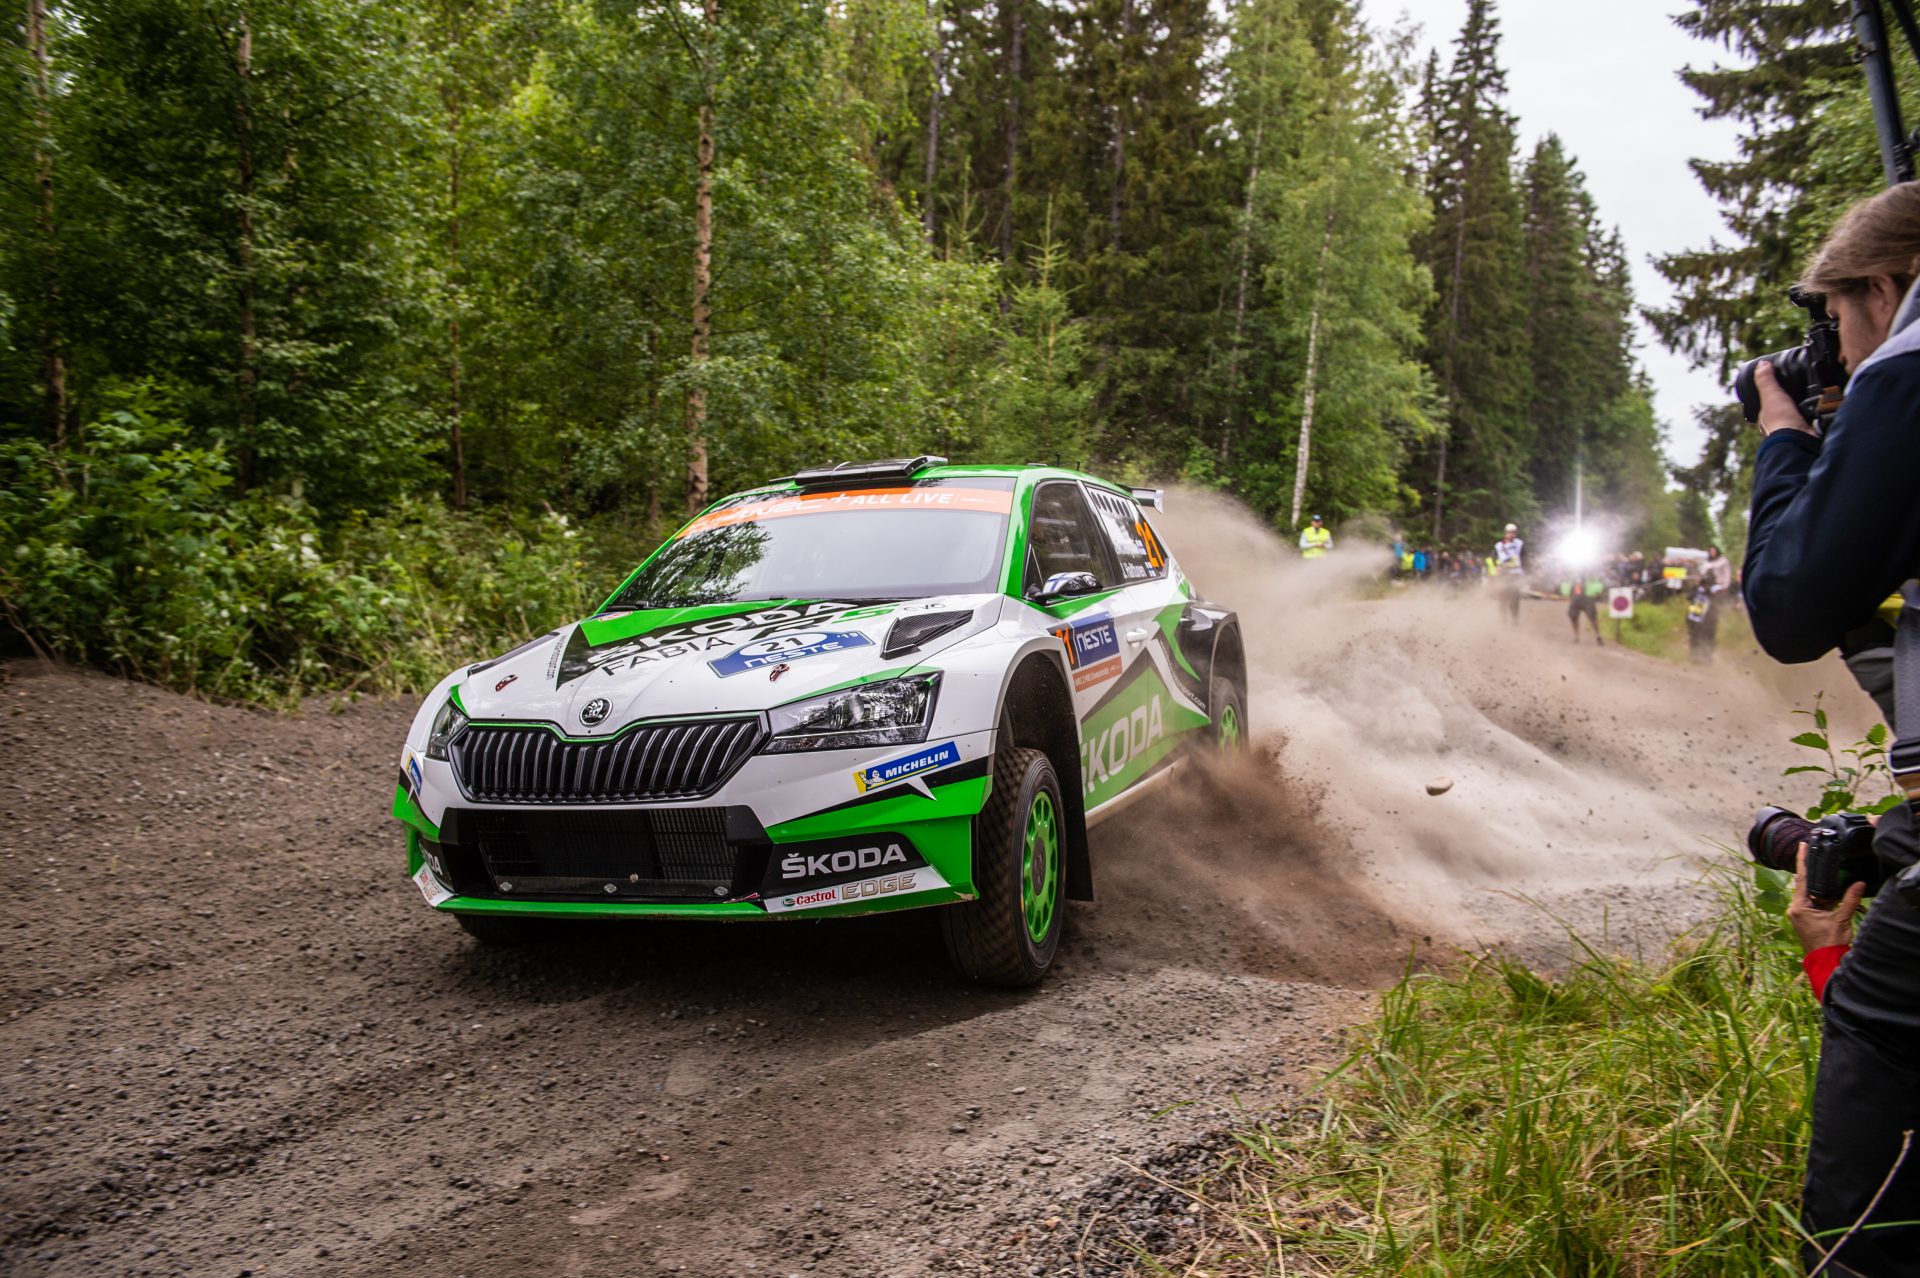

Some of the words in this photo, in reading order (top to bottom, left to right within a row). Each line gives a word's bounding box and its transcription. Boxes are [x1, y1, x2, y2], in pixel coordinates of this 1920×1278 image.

[850, 493, 892, 506] ALL
[899, 493, 953, 504] LIVE
[759, 636, 805, 653] 21
[1075, 624, 1113, 653] NESTE
[601, 636, 736, 676] FABIA
[743, 641, 844, 669] NESTE
[885, 750, 949, 778] MICHELIN
[781, 843, 907, 879] ŠKODA
[796, 889, 837, 906] Castrol
[841, 872, 917, 900] EDGE
